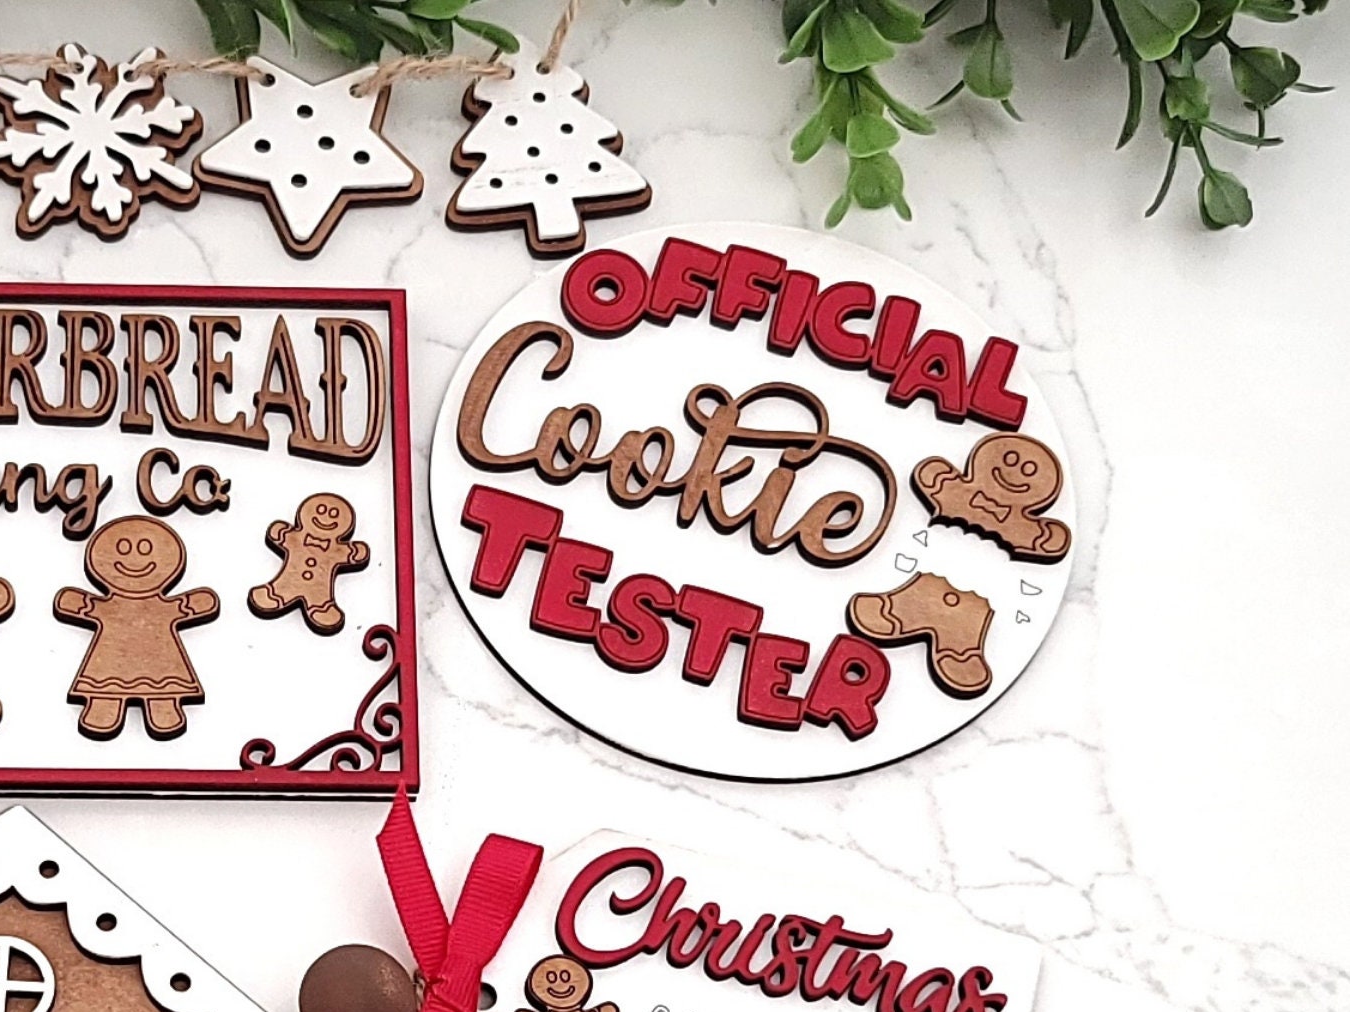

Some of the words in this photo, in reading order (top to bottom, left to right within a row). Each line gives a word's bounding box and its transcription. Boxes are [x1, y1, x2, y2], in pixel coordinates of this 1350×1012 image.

[456, 320, 897, 567] Cookie
[561, 237, 1027, 432] OFFICIAL
[461, 484, 890, 741] TESTER
